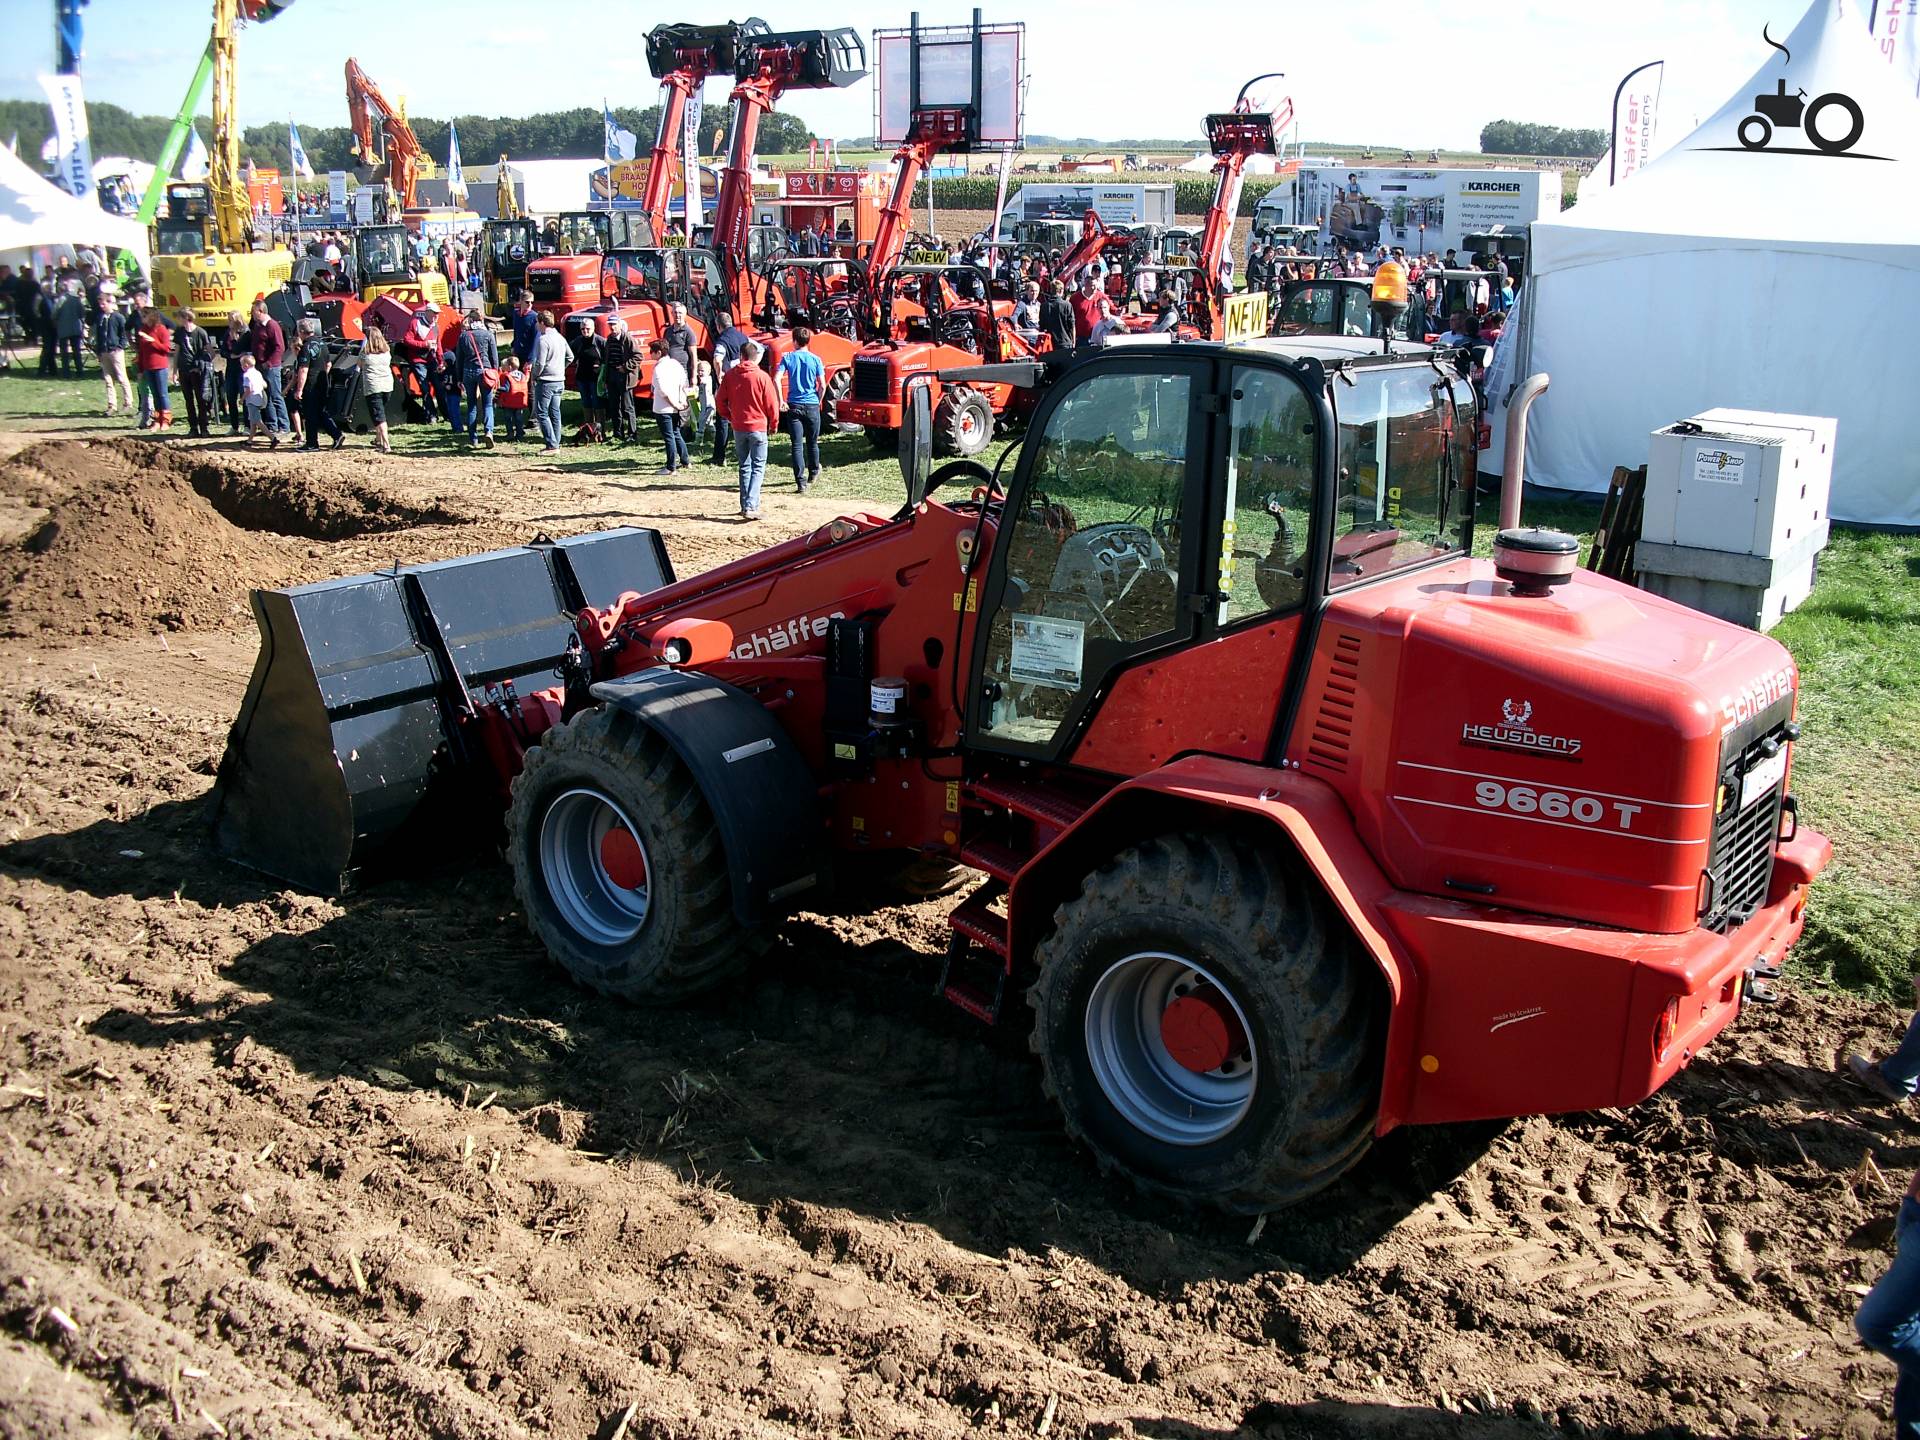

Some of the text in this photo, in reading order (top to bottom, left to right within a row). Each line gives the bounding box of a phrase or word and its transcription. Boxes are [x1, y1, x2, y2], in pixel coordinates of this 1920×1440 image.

[1468, 182, 1521, 192] KÄRCHER
[664, 236, 686, 247] NEW
[915, 251, 946, 263] NEW
[1168, 256, 1188, 266] NEW
[191, 288, 236, 302] RENT
[1228, 299, 1265, 338] NEW
[726, 611, 846, 660] chäffe
[1462, 722, 1582, 755] HEUSDENS
[1475, 781, 1642, 829] 9660 T
